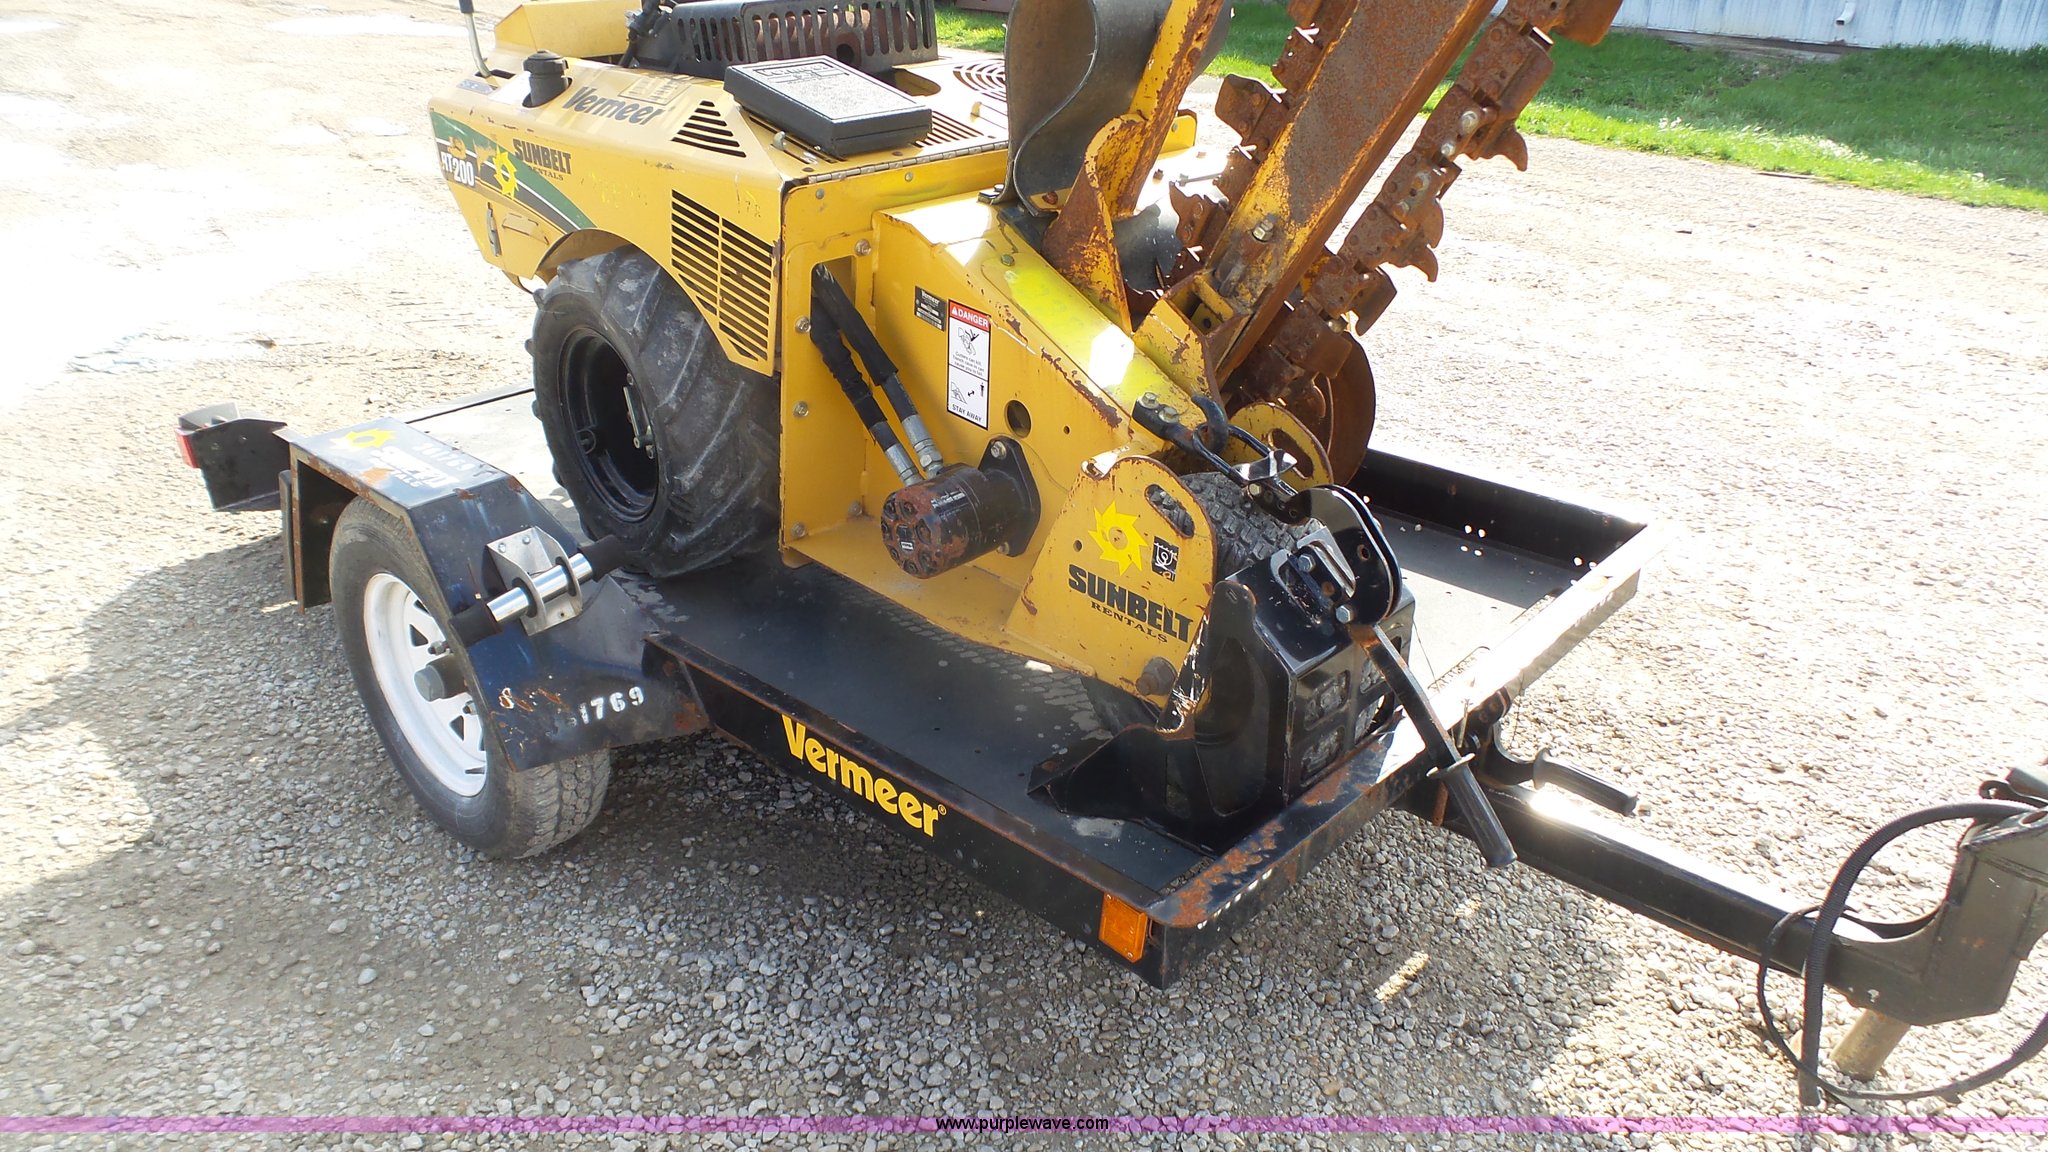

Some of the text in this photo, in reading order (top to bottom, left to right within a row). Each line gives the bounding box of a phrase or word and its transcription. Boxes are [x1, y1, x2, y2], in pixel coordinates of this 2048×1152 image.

[562, 86, 664, 125] Vermeer
[512, 138, 572, 175] SUNBELT
[957, 309, 989, 328] DANGER
[952, 403, 982, 423] STAY AWAY
[1068, 564, 1194, 643] SUNBELT
[1091, 601, 1168, 643] RENTALS
